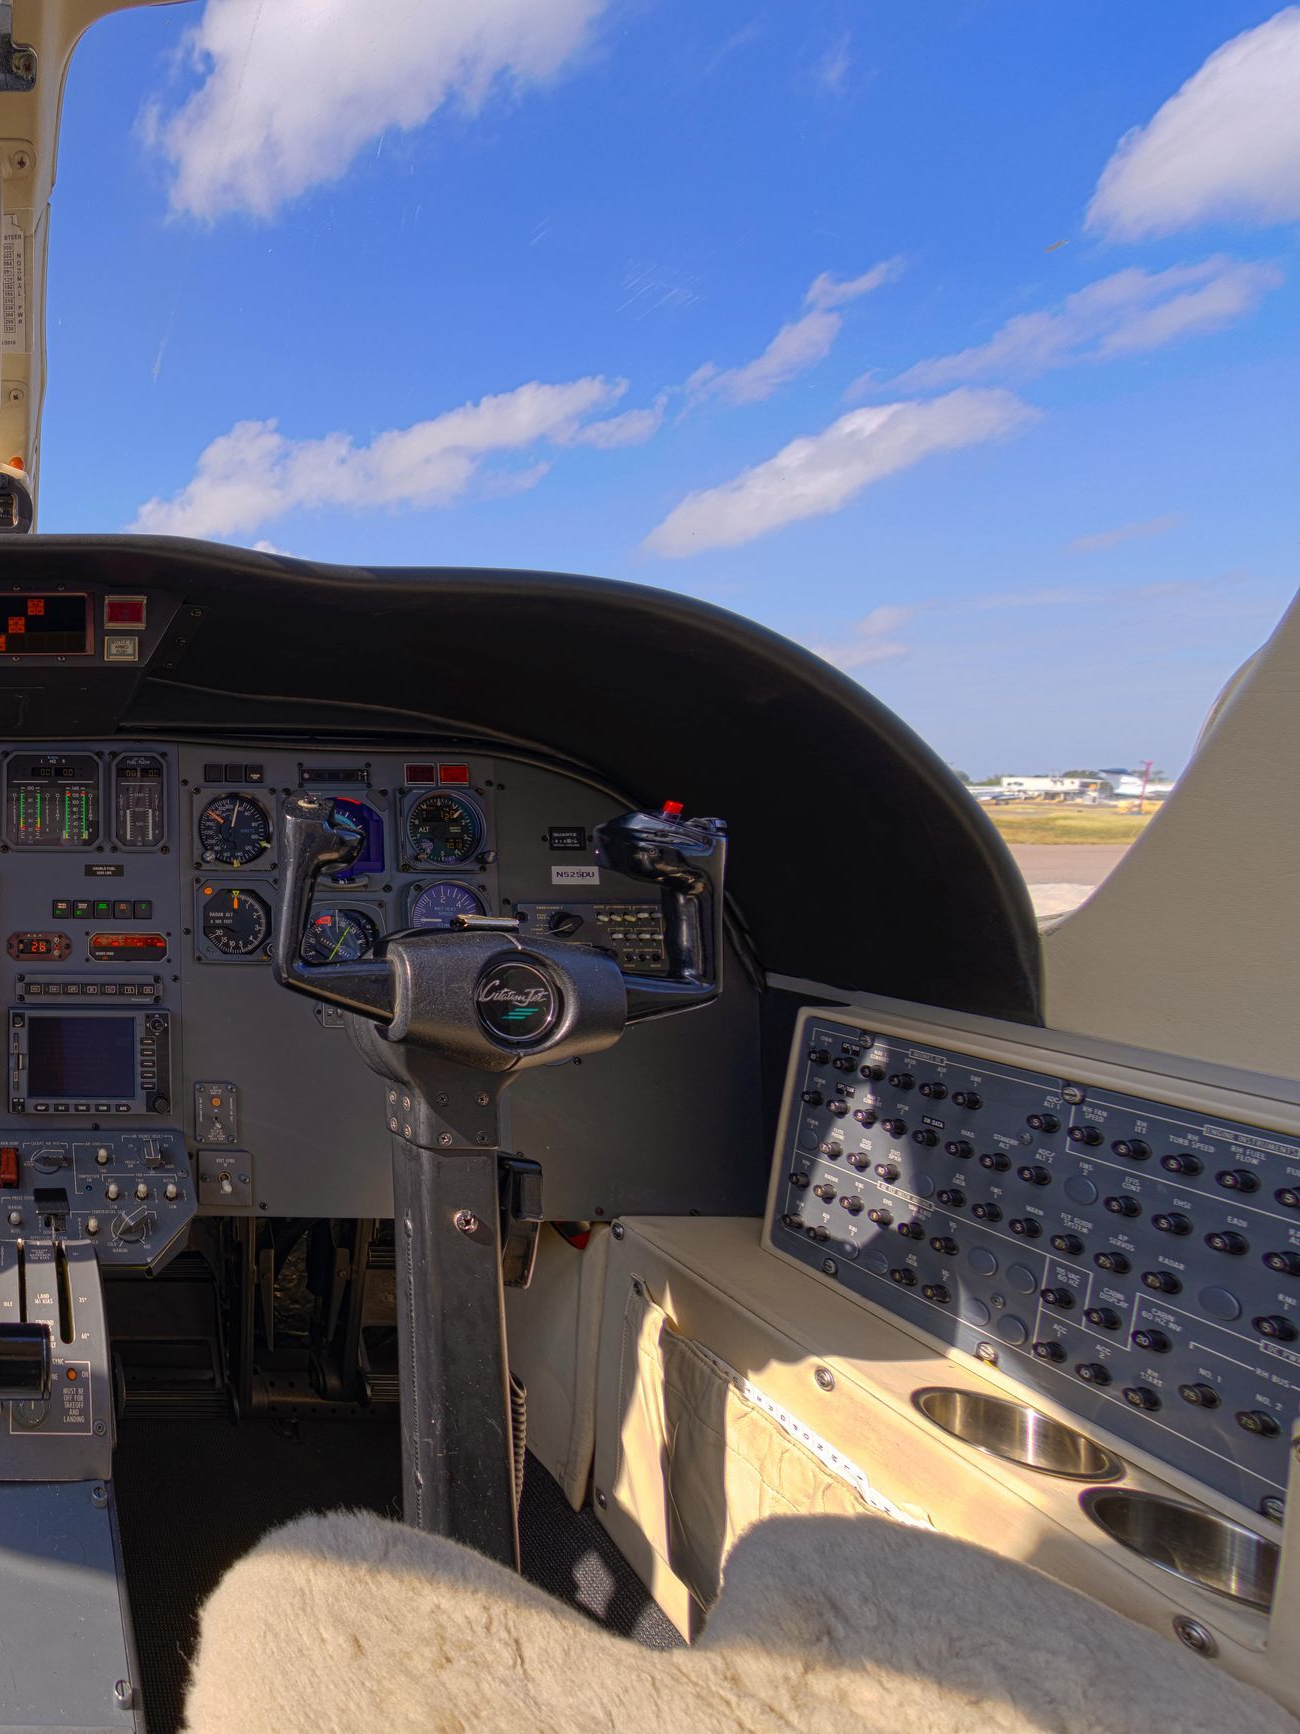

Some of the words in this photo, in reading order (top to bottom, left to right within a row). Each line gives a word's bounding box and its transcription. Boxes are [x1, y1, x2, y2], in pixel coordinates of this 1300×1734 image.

[1084, 1112, 1104, 1123] SPEED
[1094, 1108, 1107, 1117] FAN
[1187, 1133, 1199, 1141] RH
[1208, 1126, 1238, 1141] ENGINE
[1239, 1134, 1297, 1157] INSTRUMENTS
[1169, 1135, 1187, 1146] TURB
[1191, 1141, 1215, 1153] SPEED
[1230, 1145, 1243, 1153] RH
[1245, 1148, 1267, 1160] FUEL
[1236, 1154, 1259, 1165] FLOW
[1122, 1182, 1141, 1193] CONT
[1125, 1176, 1140, 1186] EFIS
[1063, 1220, 1089, 1235] SYSTEM
[1227, 1217, 1247, 1227] EADI
[1109, 1239, 1135, 1252] SERVOS
[1158, 1256, 1185, 1272] RADAR
[1103, 1287, 1125, 1301] CABIN
[1100, 1293, 1129, 1310] DISPLAY
[1141, 1310, 1153, 1320] 60
[1155, 1316, 1167, 1327] HZ
[1151, 1308, 1174, 1322] CABIN
[1053, 1323, 1068, 1334] ACC
[1138, 1335, 1149, 1346] 20
[1096, 1344, 1111, 1356] ACC
[1140, 1372, 1163, 1387] START
[1147, 1368, 1158, 1378] RH
[1198, 1368, 1214, 1380] NO.
[1255, 1367, 1270, 1380] RH
[1271, 1374, 1291, 1389] BUS
[1186, 1388, 1197, 1401] 75
[1256, 1393, 1271, 1406] NO.
[1241, 1414, 1255, 1428] 75
